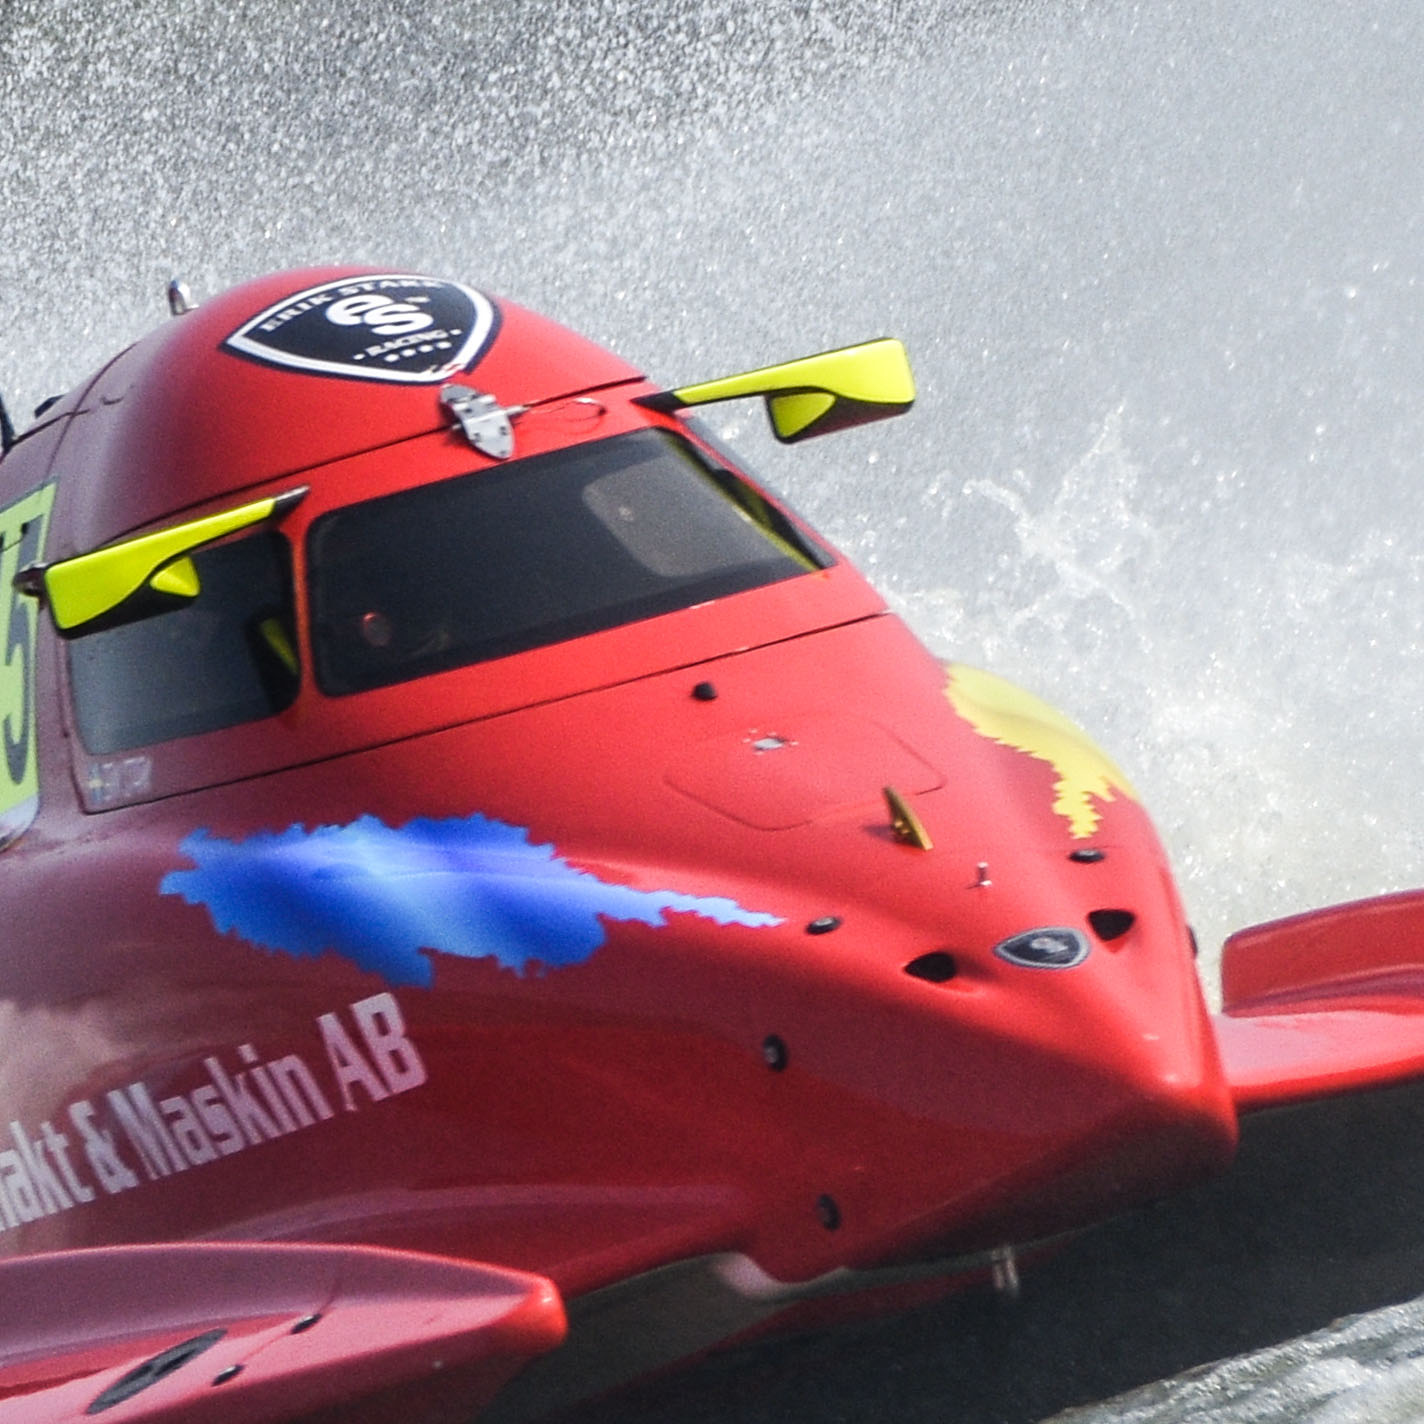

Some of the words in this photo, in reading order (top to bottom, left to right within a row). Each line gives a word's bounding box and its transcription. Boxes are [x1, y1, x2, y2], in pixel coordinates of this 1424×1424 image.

[260, 295, 332, 332] ERIK
[365, 329, 449, 356] RACING
[69, 1100, 138, 1195] &
[107, 1044, 336, 1180] Maskin
[316, 991, 428, 1112] AB
